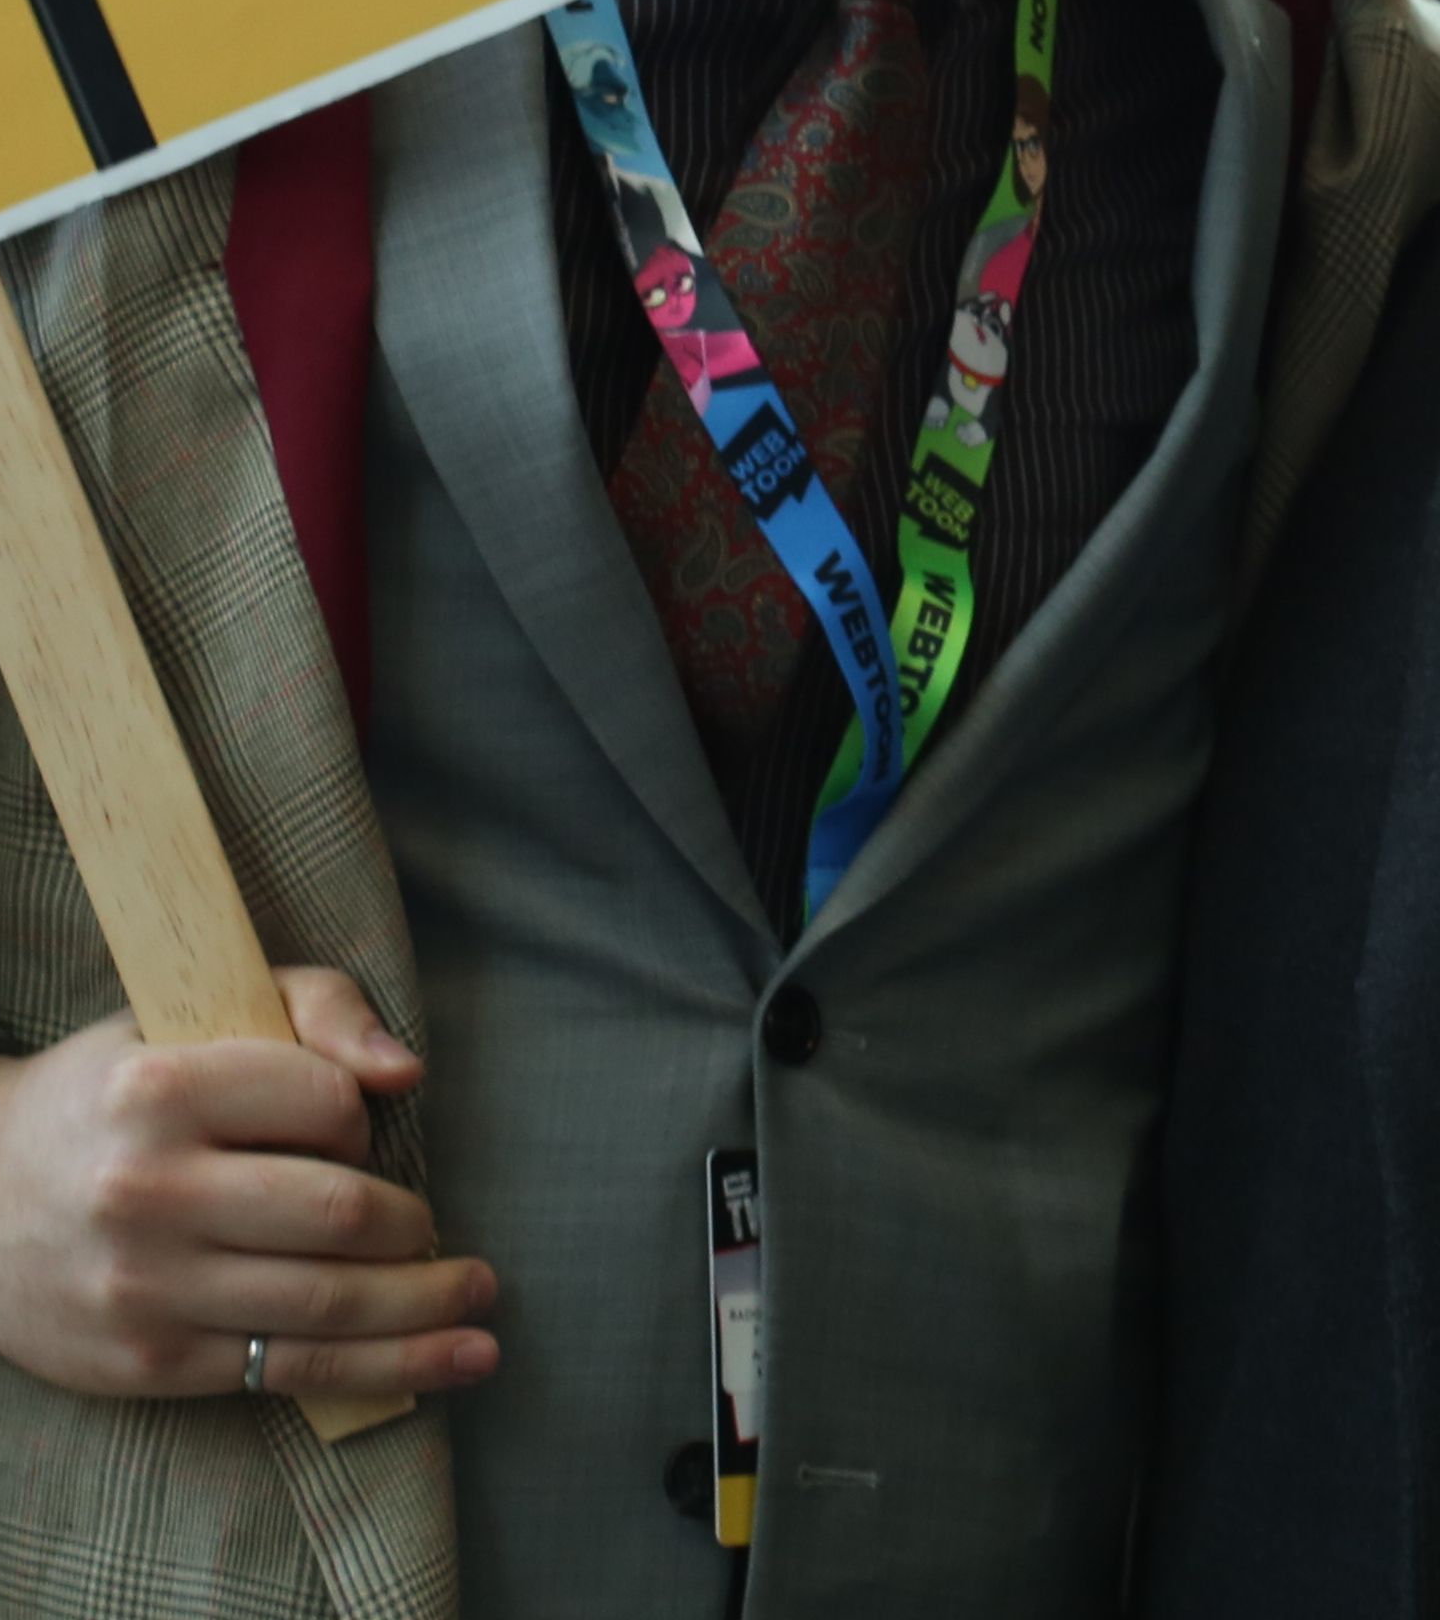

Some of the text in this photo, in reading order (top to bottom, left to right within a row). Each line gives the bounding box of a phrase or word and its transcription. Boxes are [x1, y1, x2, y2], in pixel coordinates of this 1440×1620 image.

[728, 427, 787, 482] WEB
[740, 440, 809, 506] TOON
[904, 479, 970, 542] TOON
[924, 469, 976, 524] WEB
